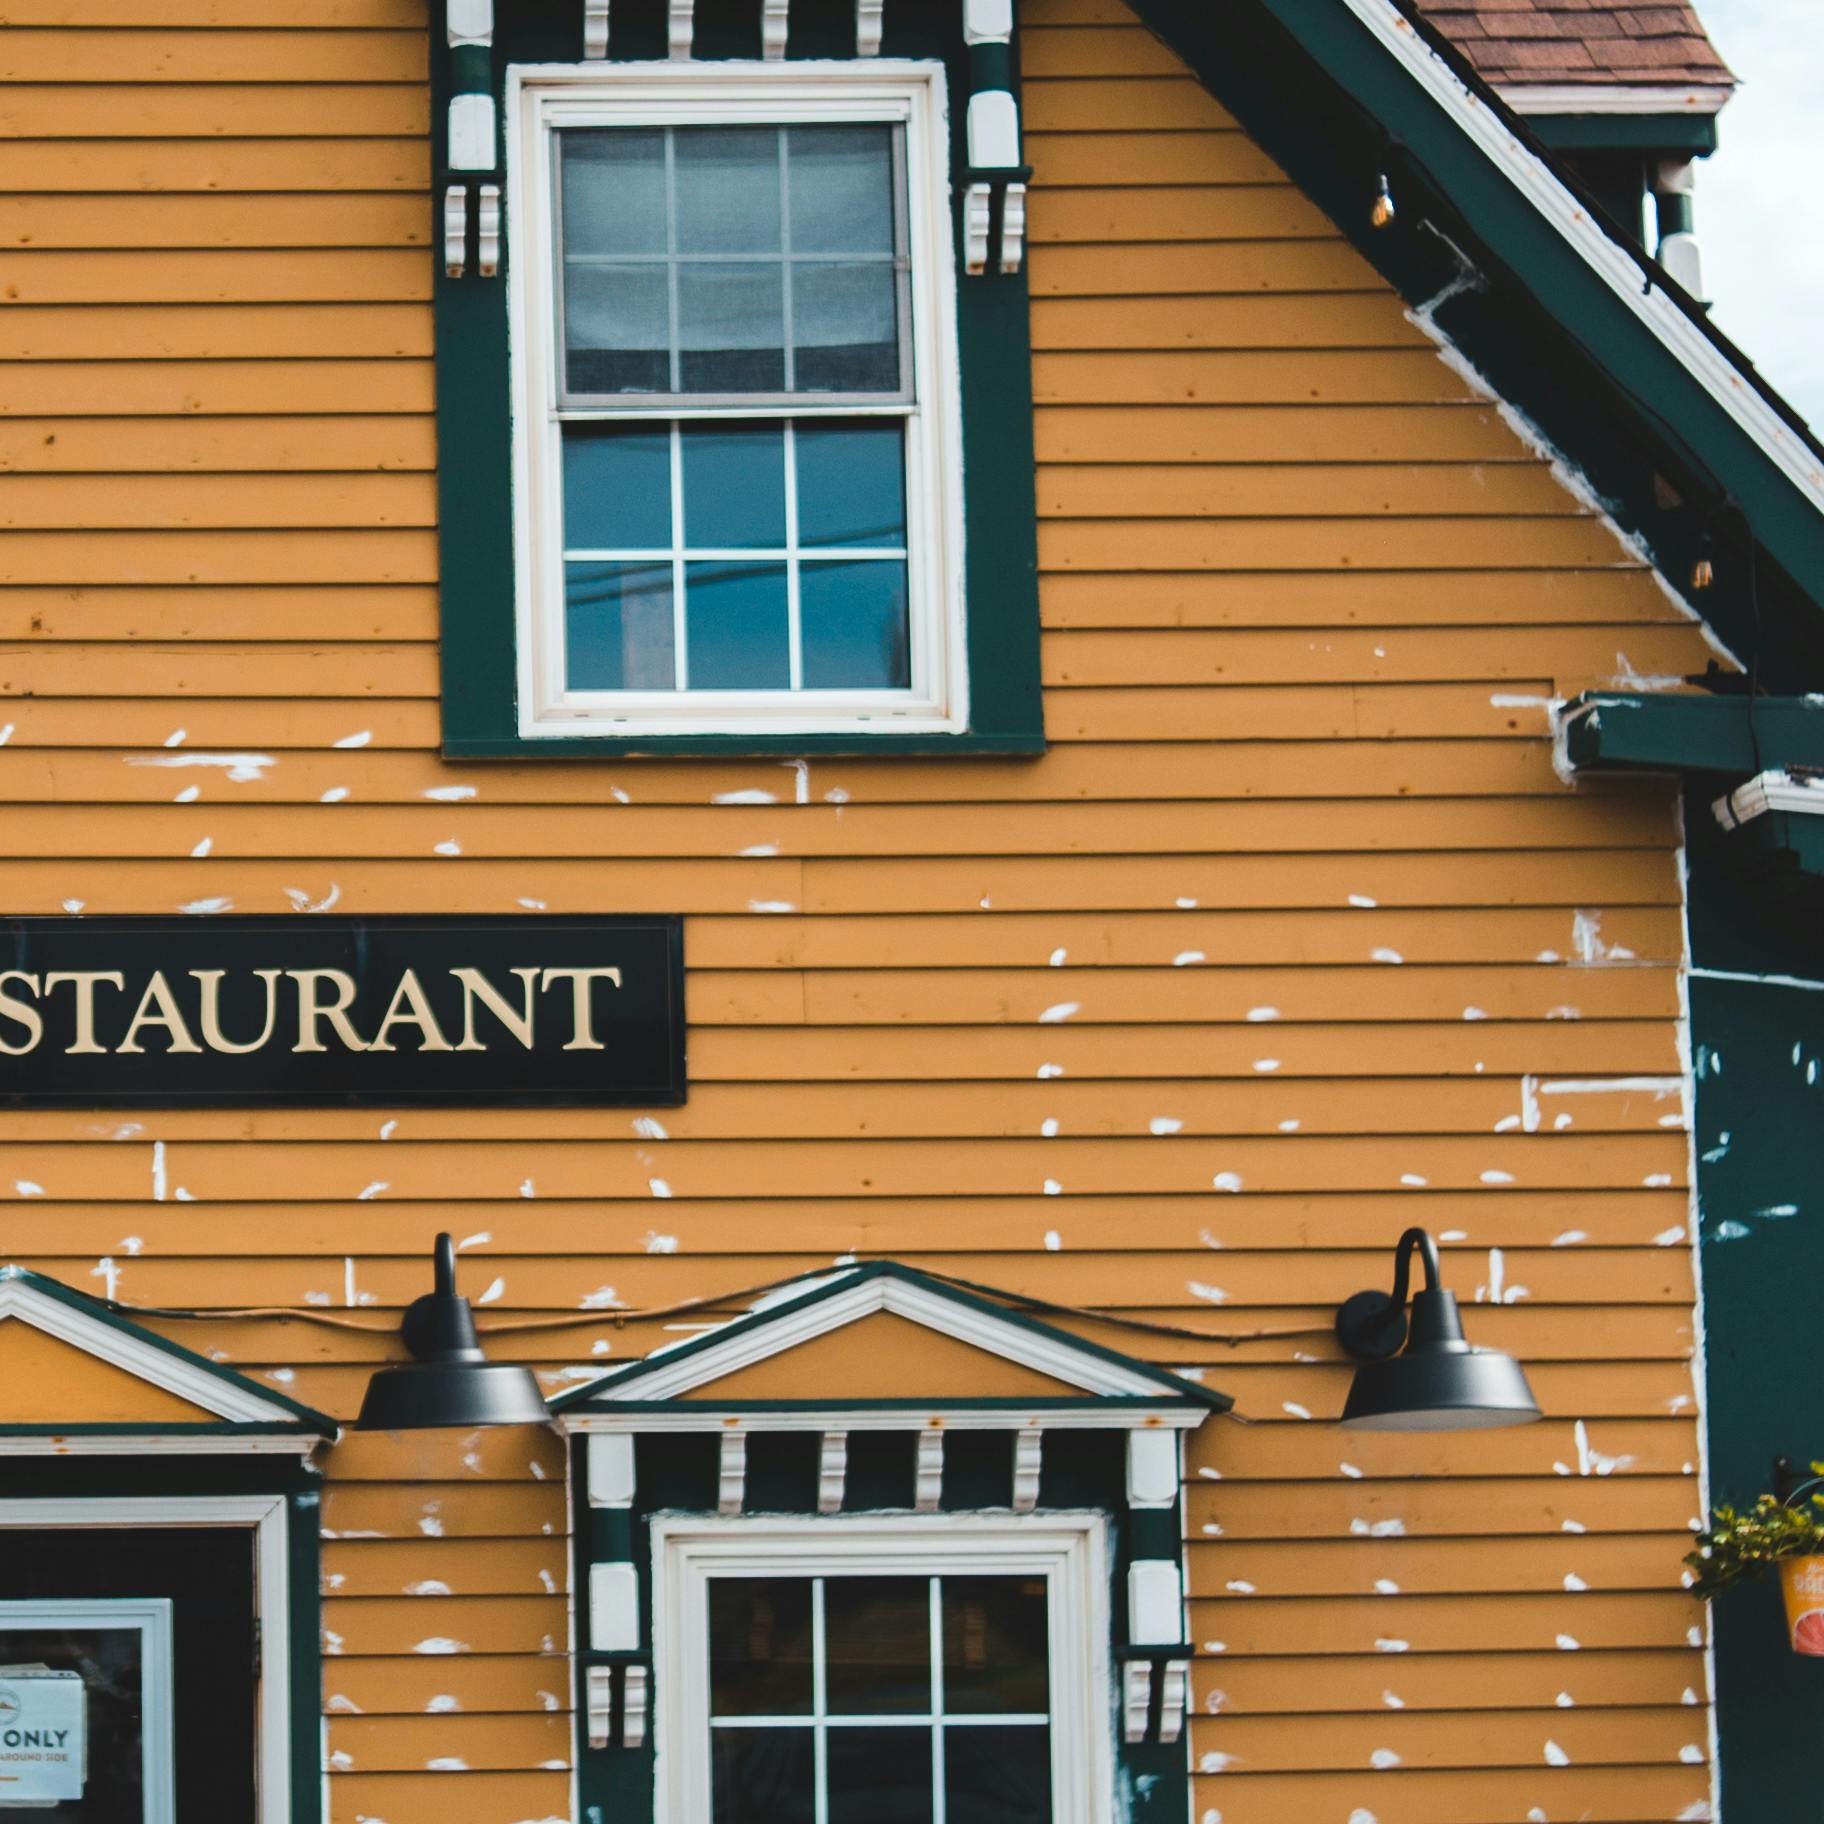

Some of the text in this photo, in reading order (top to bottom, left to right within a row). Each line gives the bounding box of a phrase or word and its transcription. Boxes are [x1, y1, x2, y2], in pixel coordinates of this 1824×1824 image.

[3, 1729, 68, 1748] ONLY
[0, 1752, 42, 1762] AROUND
[46, 1752, 69, 1763] SIDE
